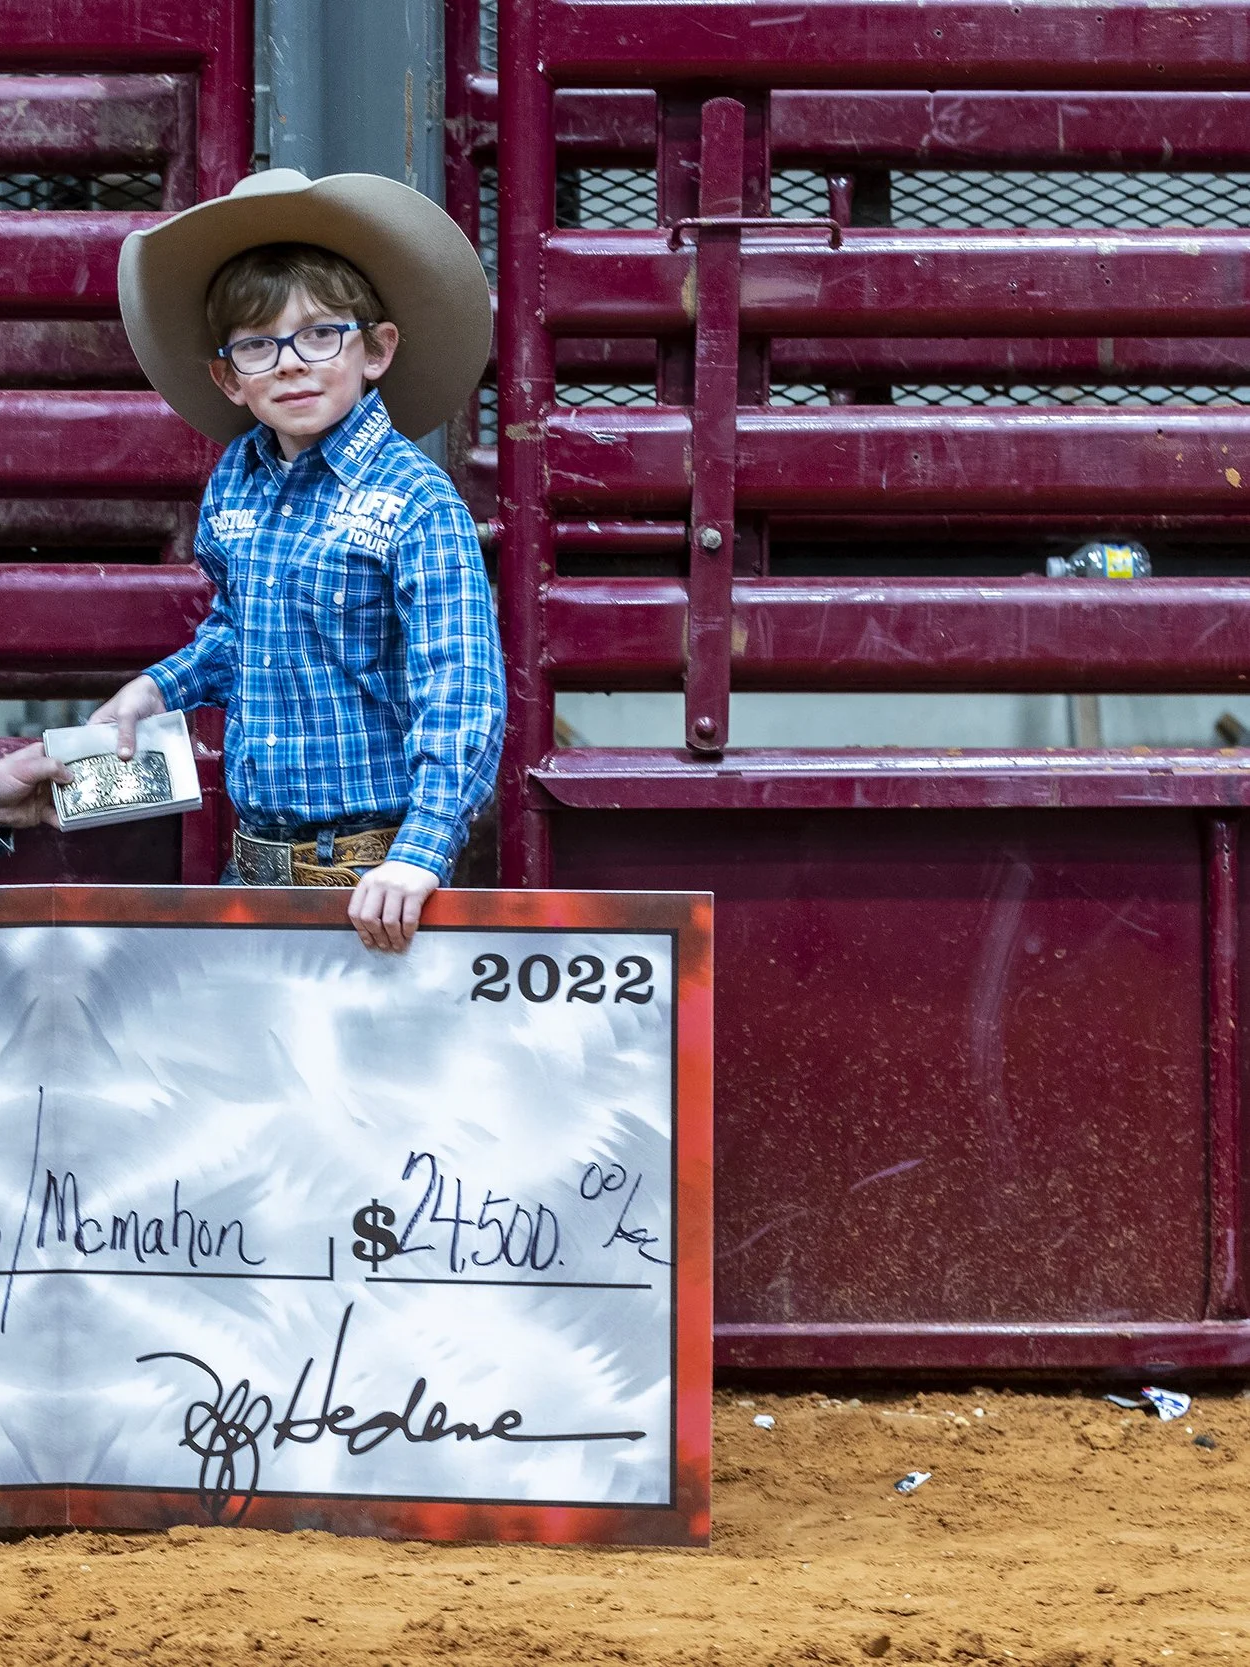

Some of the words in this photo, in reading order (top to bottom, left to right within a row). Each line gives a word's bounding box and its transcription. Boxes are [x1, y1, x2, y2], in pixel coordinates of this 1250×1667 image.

[335, 484, 408, 522] TUFF
[347, 528, 391, 555] TOUR
[470, 953, 654, 1003] 2022
